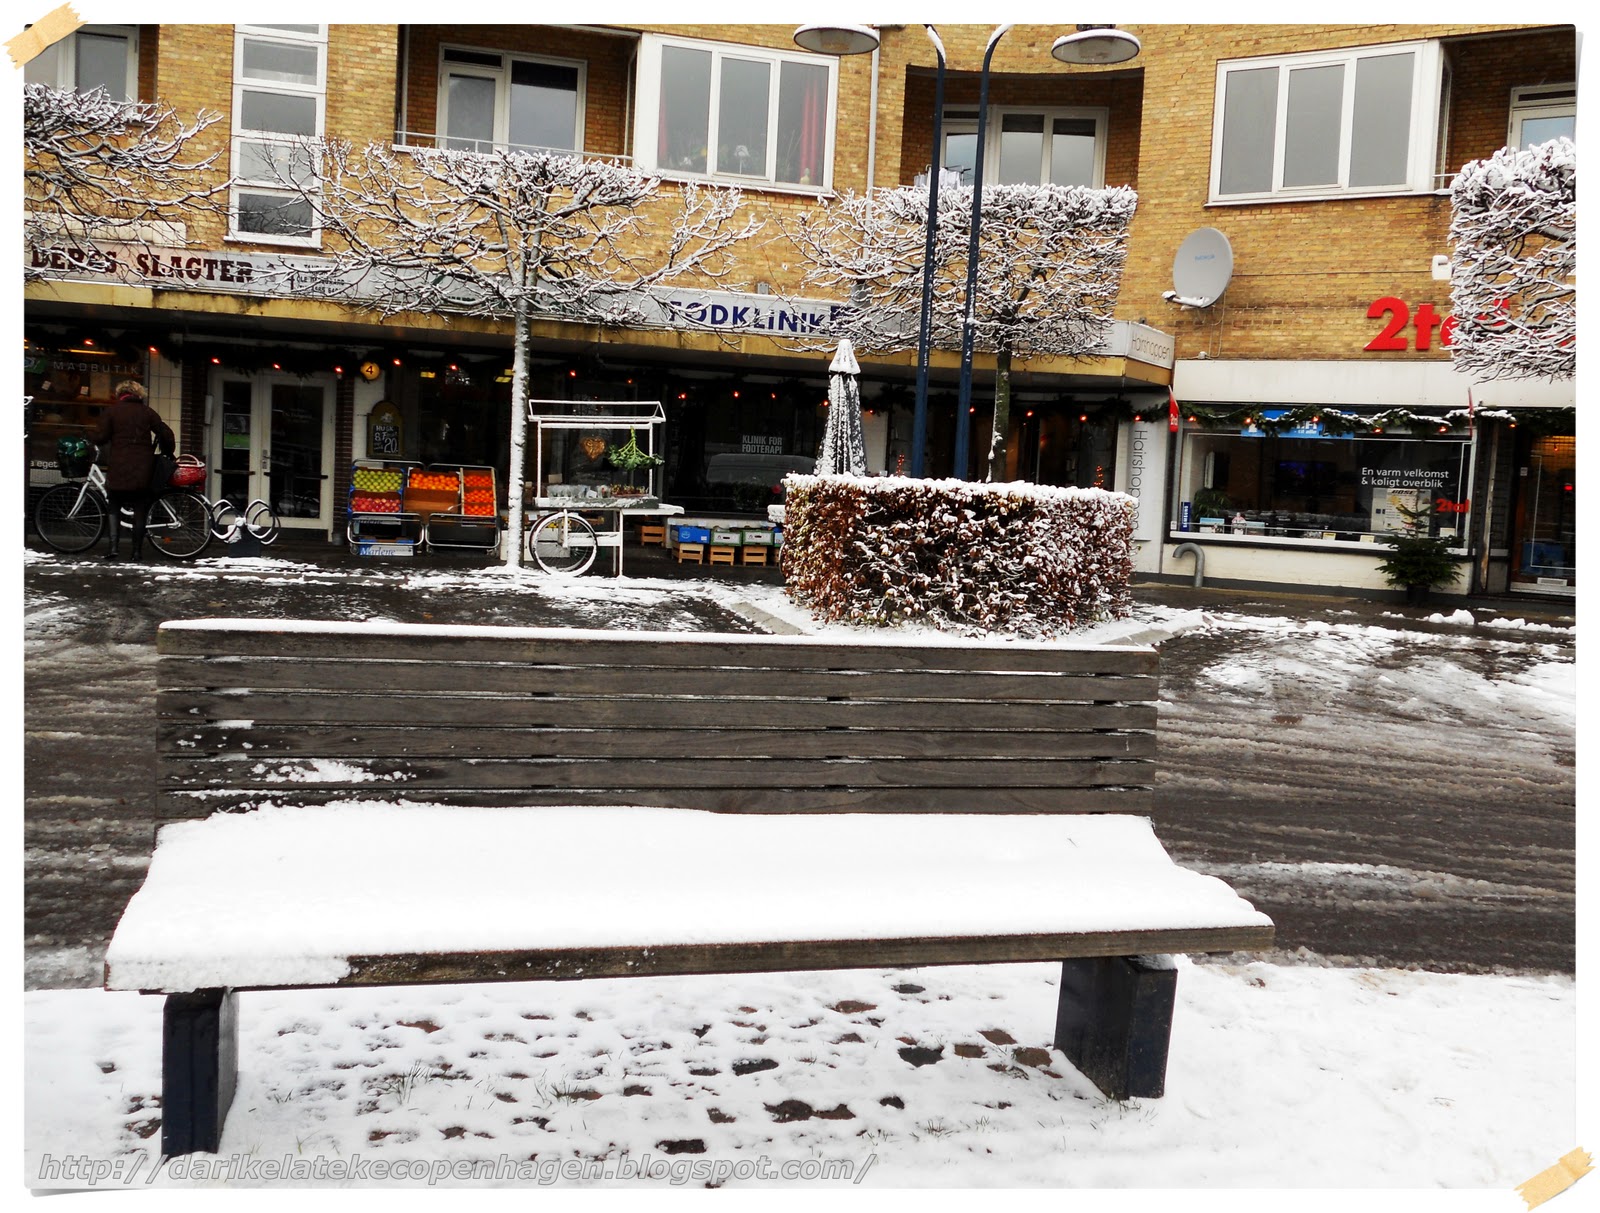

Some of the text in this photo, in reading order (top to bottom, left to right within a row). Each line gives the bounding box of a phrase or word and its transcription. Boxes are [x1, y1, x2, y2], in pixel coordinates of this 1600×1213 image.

[137, 253, 253, 283] SLAGTER
[53, 361, 140, 375] MADBUTIK
[366, 365, 374, 375] 4
[743, 435, 783, 446] KLINIK FOR
[36, 460, 59, 470] eget
[1361, 467, 1450, 479] En varm velkomst
[1361, 477, 1443, 488] & køligt overblik
[1436, 498, 1470, 513] 2tal
